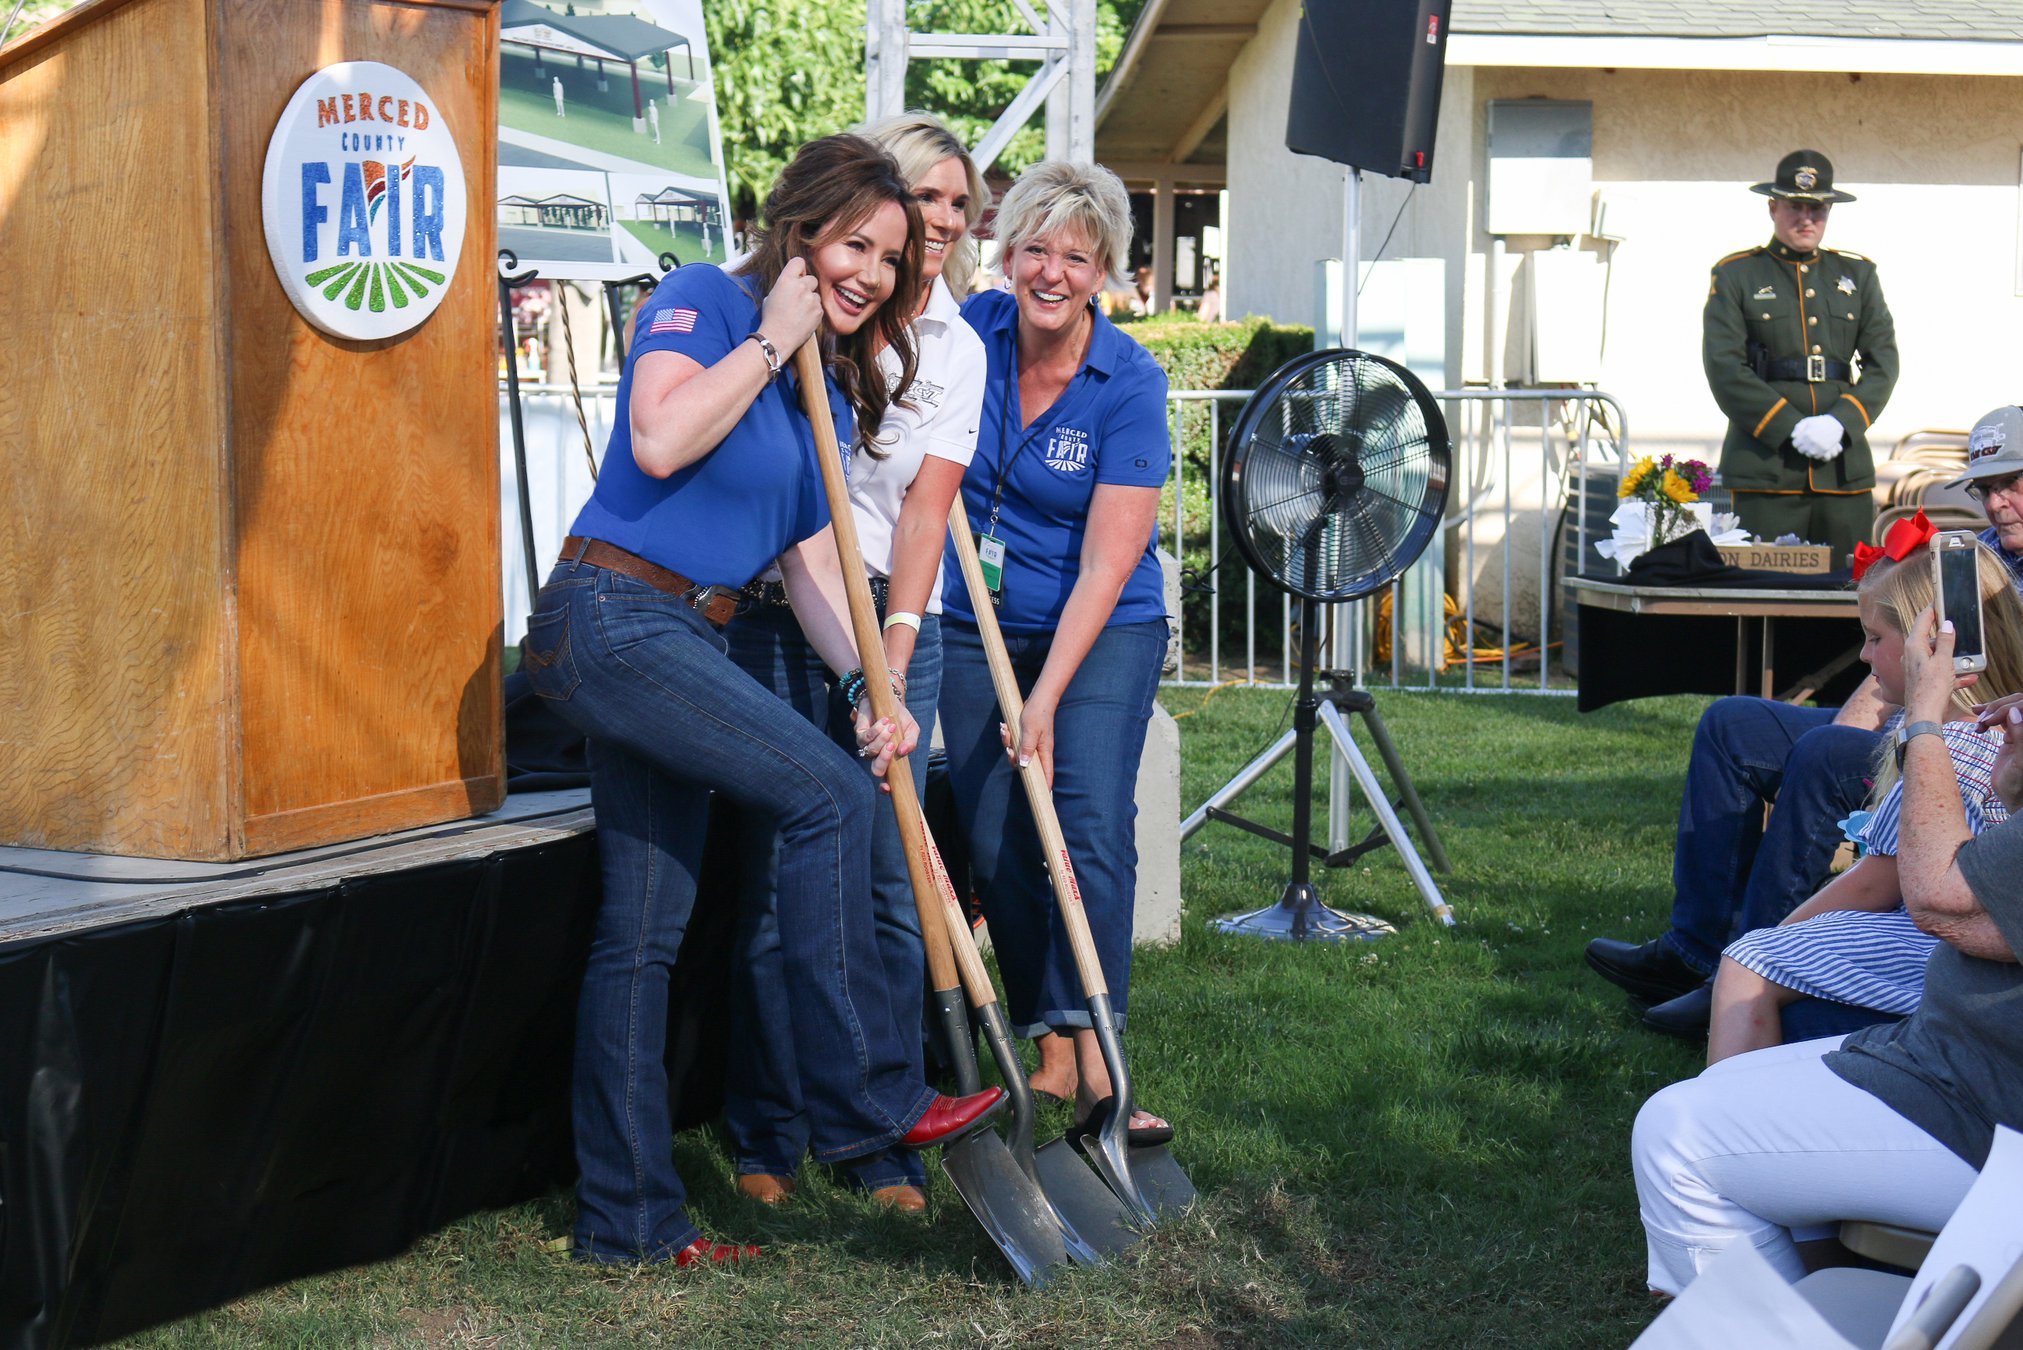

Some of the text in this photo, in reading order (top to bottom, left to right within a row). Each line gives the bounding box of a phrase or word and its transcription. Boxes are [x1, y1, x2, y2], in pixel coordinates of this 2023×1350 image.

[317, 93, 429, 130] MERCED
[342, 132, 405, 152] COUNTY
[302, 161, 445, 263] FAIR
[1055, 426, 1088, 439] MERCED
[1046, 438, 1089, 464] FAIR
[1750, 552, 1820, 568] DAIRIES
